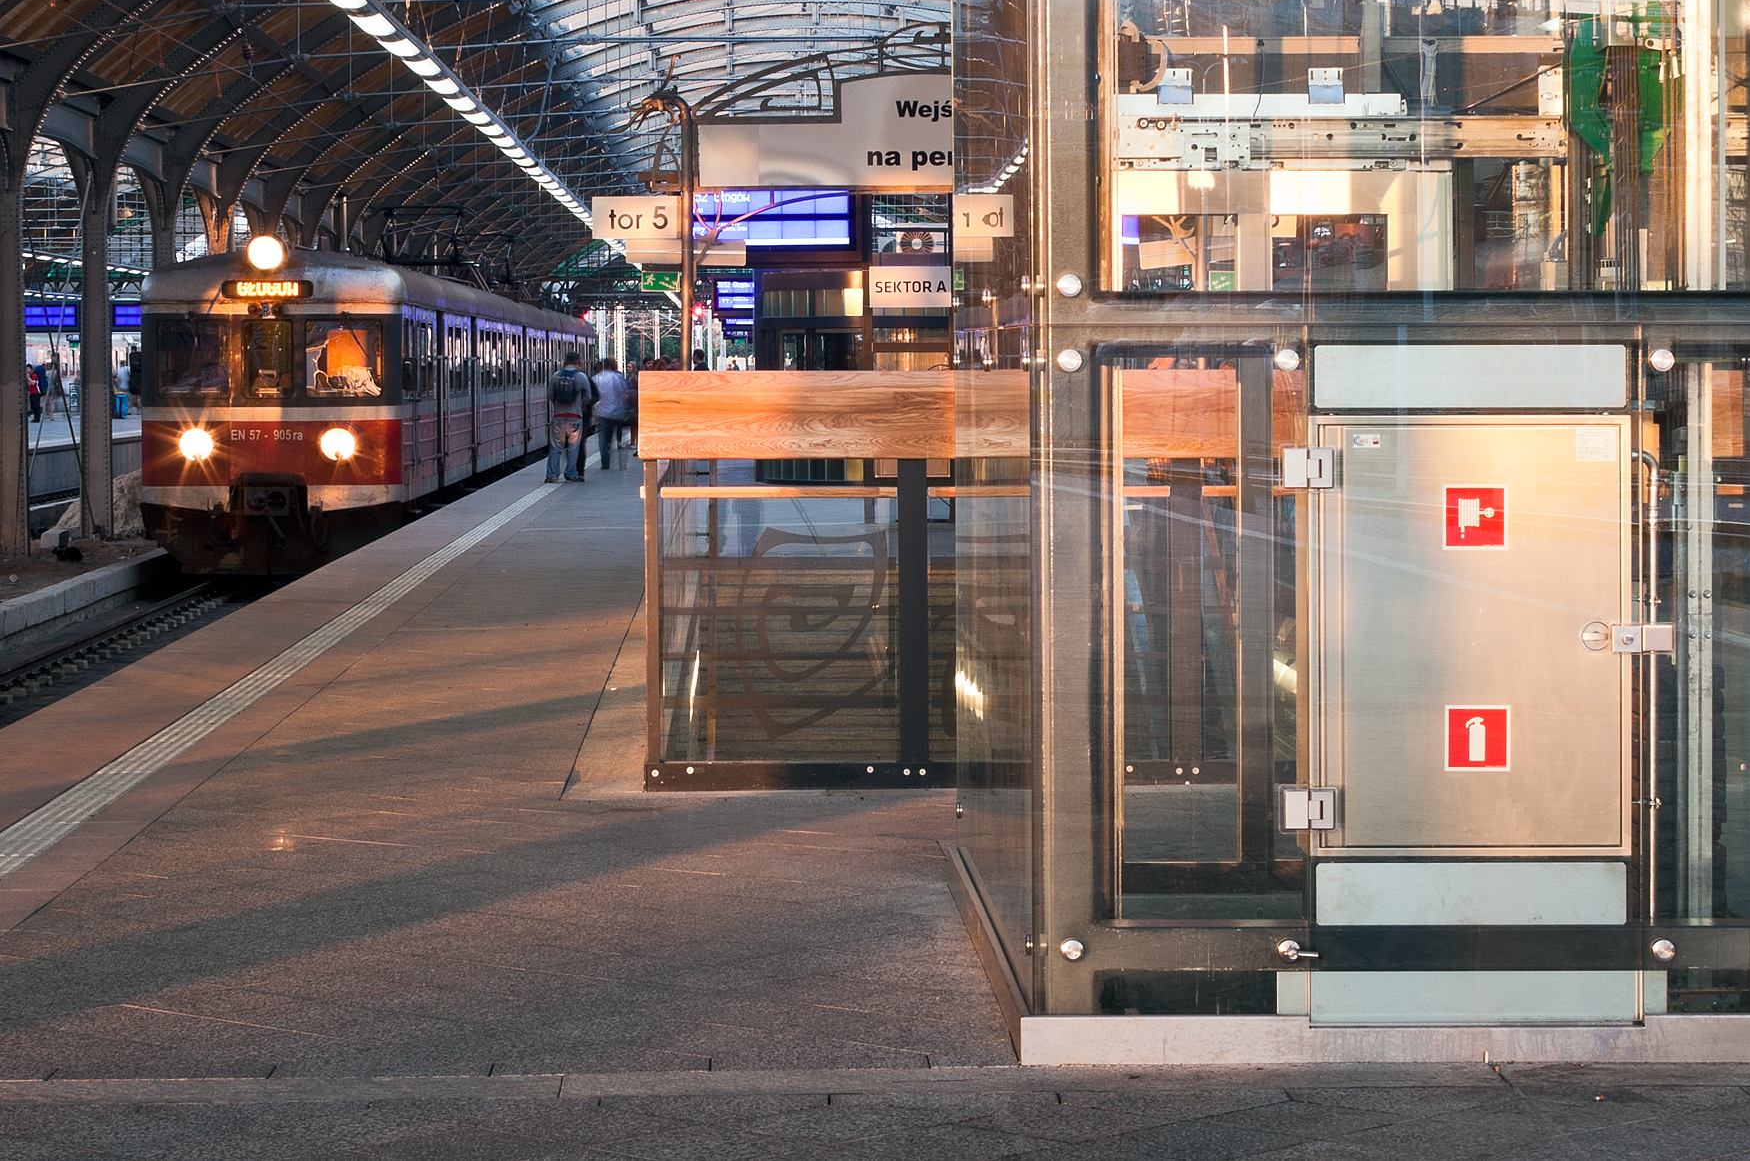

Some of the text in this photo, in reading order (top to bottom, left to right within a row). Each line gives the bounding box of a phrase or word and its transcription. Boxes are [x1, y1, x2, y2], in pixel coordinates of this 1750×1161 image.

[896, 100, 952, 122] Wejś
[867, 150, 901, 166] na
[609, 206, 668, 230] tor 5
[875, 280, 947, 293] SEKTOR A
[231, 429, 246, 441] EN
[249, 429, 261, 441] 57
